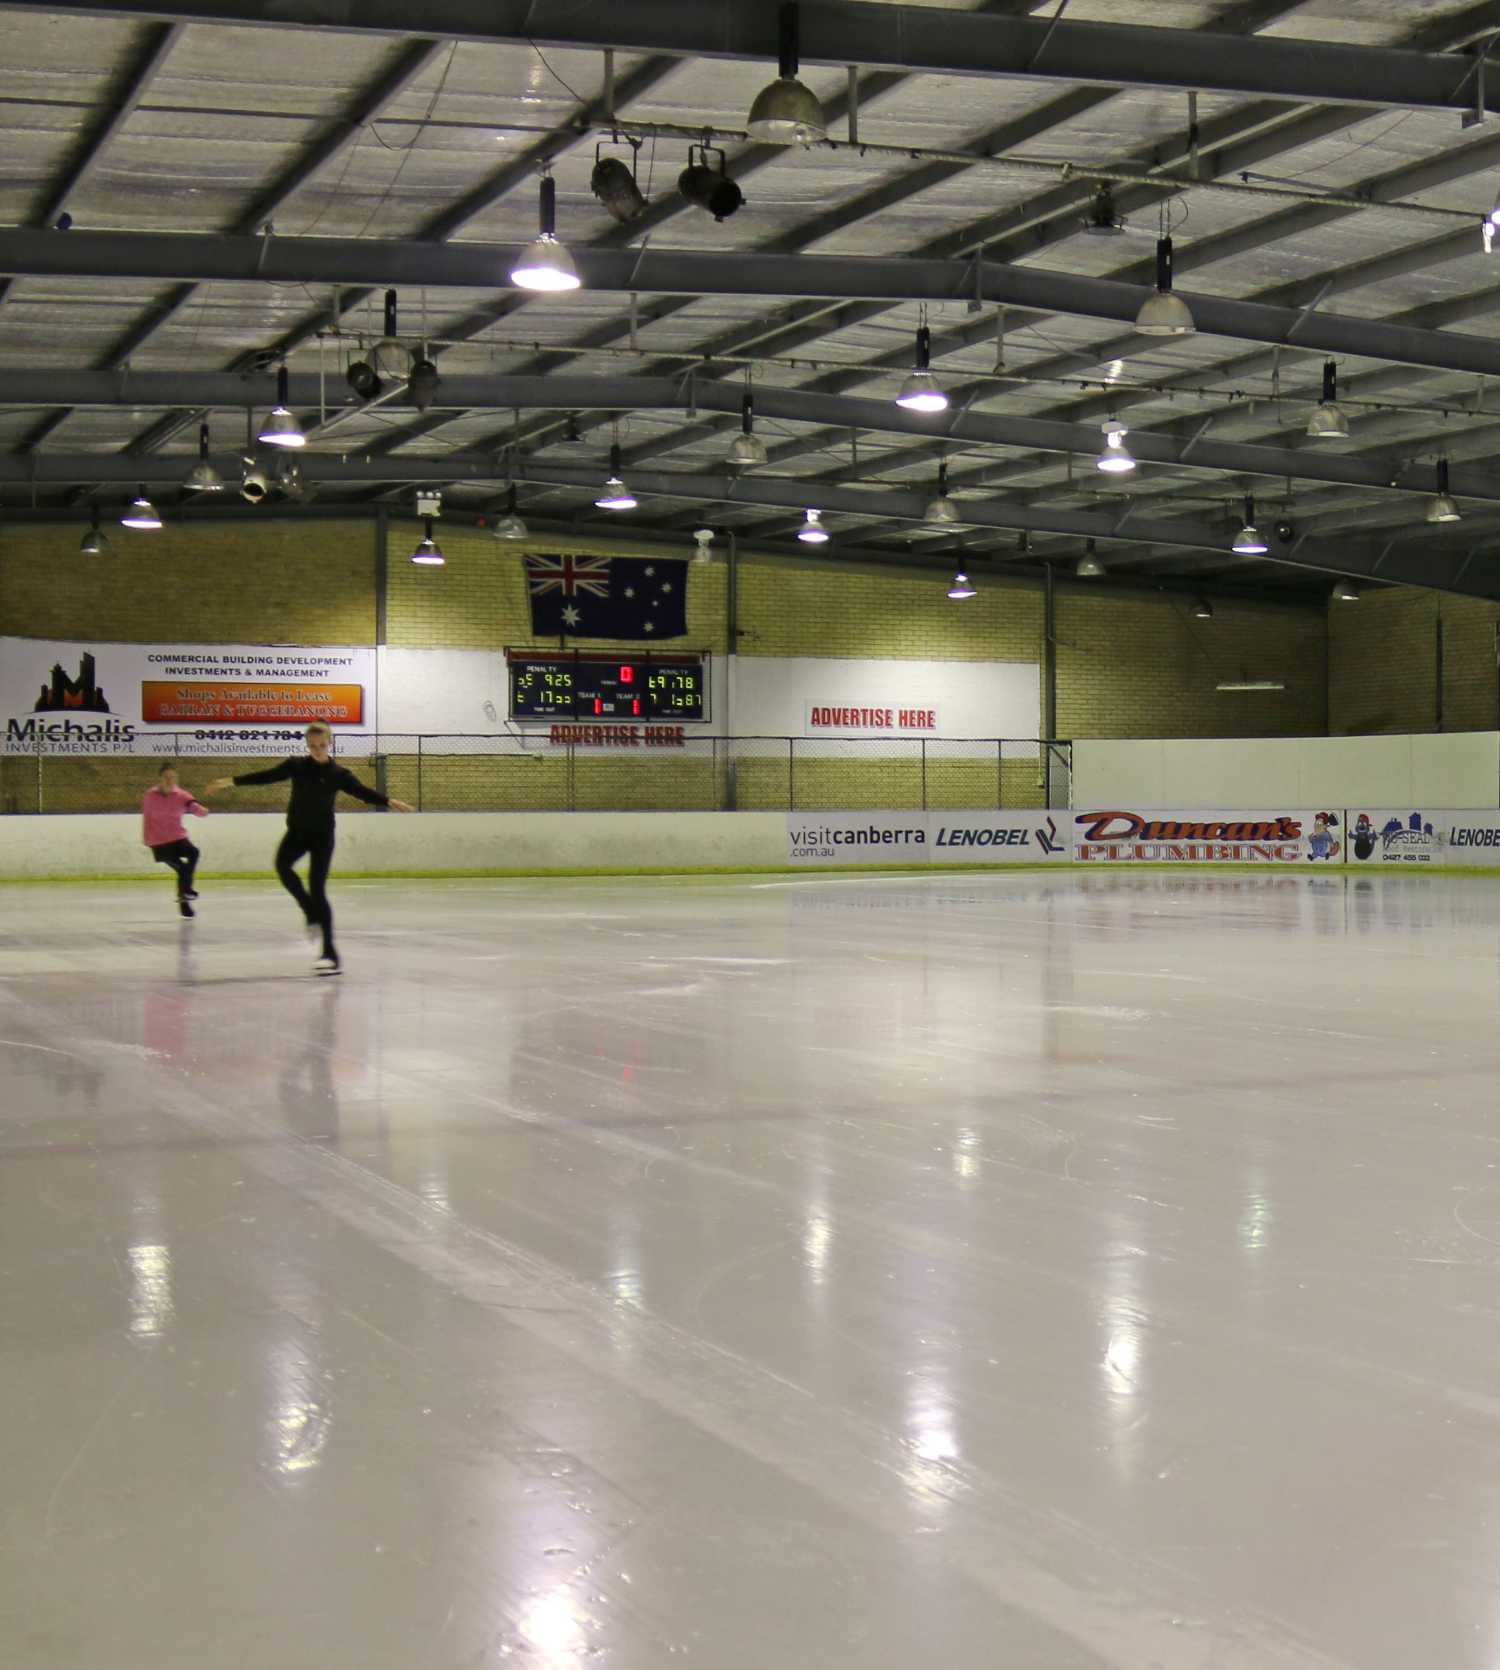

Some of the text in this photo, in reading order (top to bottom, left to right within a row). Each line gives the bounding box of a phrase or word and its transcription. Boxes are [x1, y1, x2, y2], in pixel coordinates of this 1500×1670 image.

[147, 654, 353, 666] COMMERCIAL BUILDING DEVELOPMENT
[165, 667, 329, 678] INVESTMENTS & MANAGEMENT
[811, 707, 936, 729] ADVERTISE HERE
[6, 718, 135, 742] Michalis
[551, 724, 685, 746] ADVERTISE HERE
[6, 743, 136, 753] INVESTMENTS P/L
[790, 825, 925, 846] visitcanberra
[1075, 811, 1302, 841] Duncan's
[936, 827, 1030, 847] LENOBEL
[1075, 843, 1303, 861] PLUMBING
